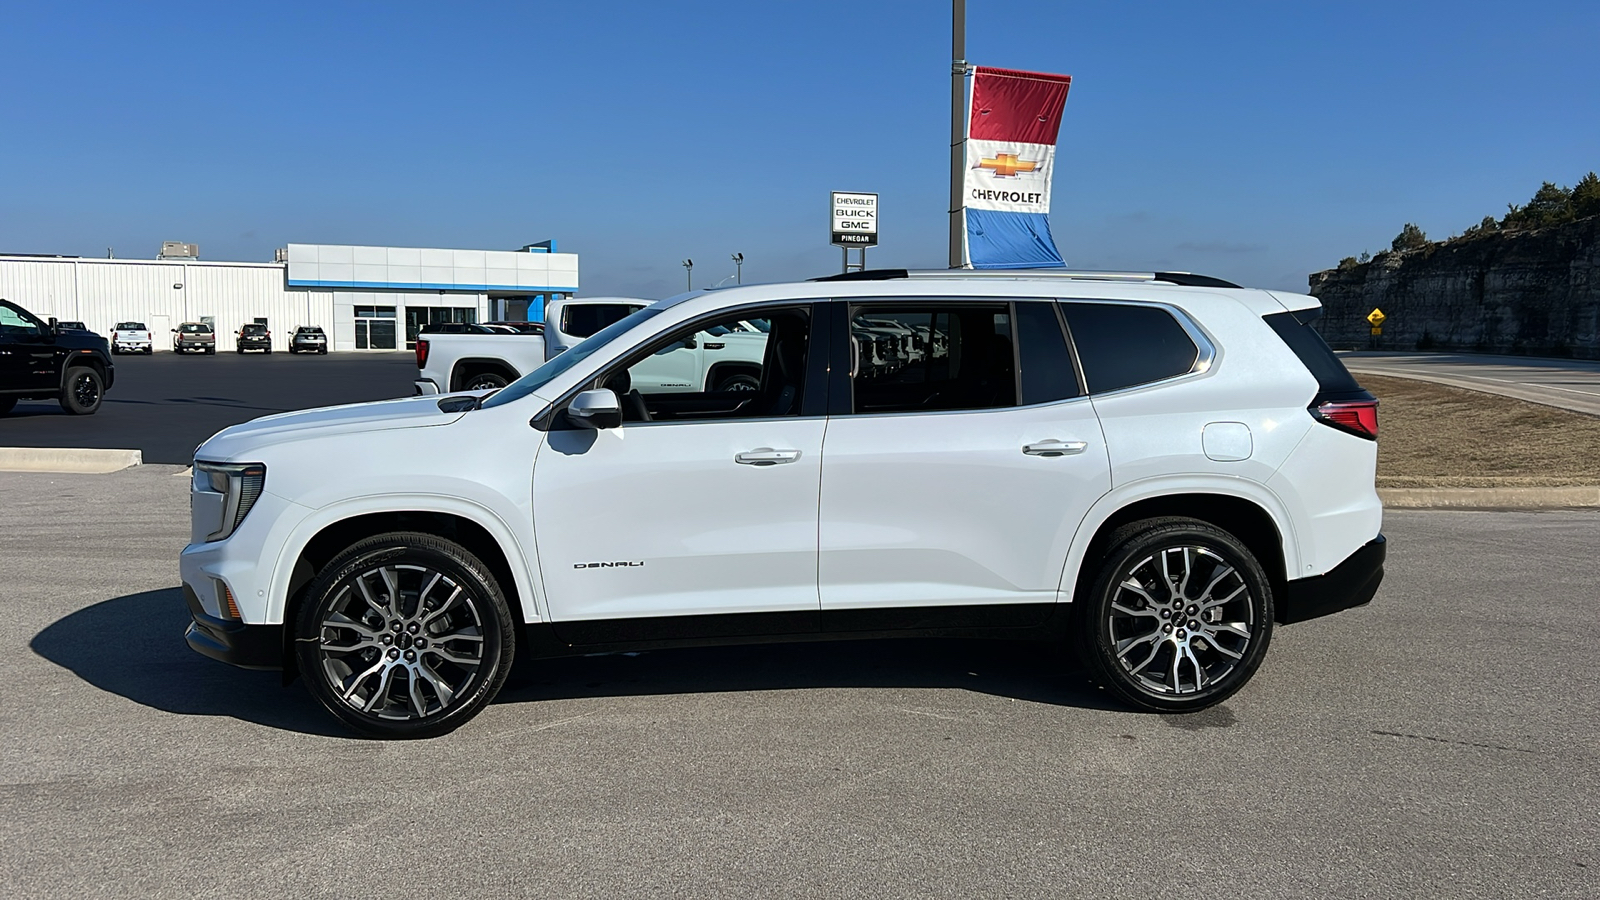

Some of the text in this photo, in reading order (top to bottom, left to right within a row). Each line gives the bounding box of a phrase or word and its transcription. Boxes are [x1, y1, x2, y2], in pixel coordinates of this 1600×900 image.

[972, 188, 1042, 204] CHEVROLET
[836, 197, 874, 206] CHEVROLET
[836, 209, 874, 218] BUICK
[841, 221, 870, 229] GMC
[573, 561, 644, 569] DENALI
